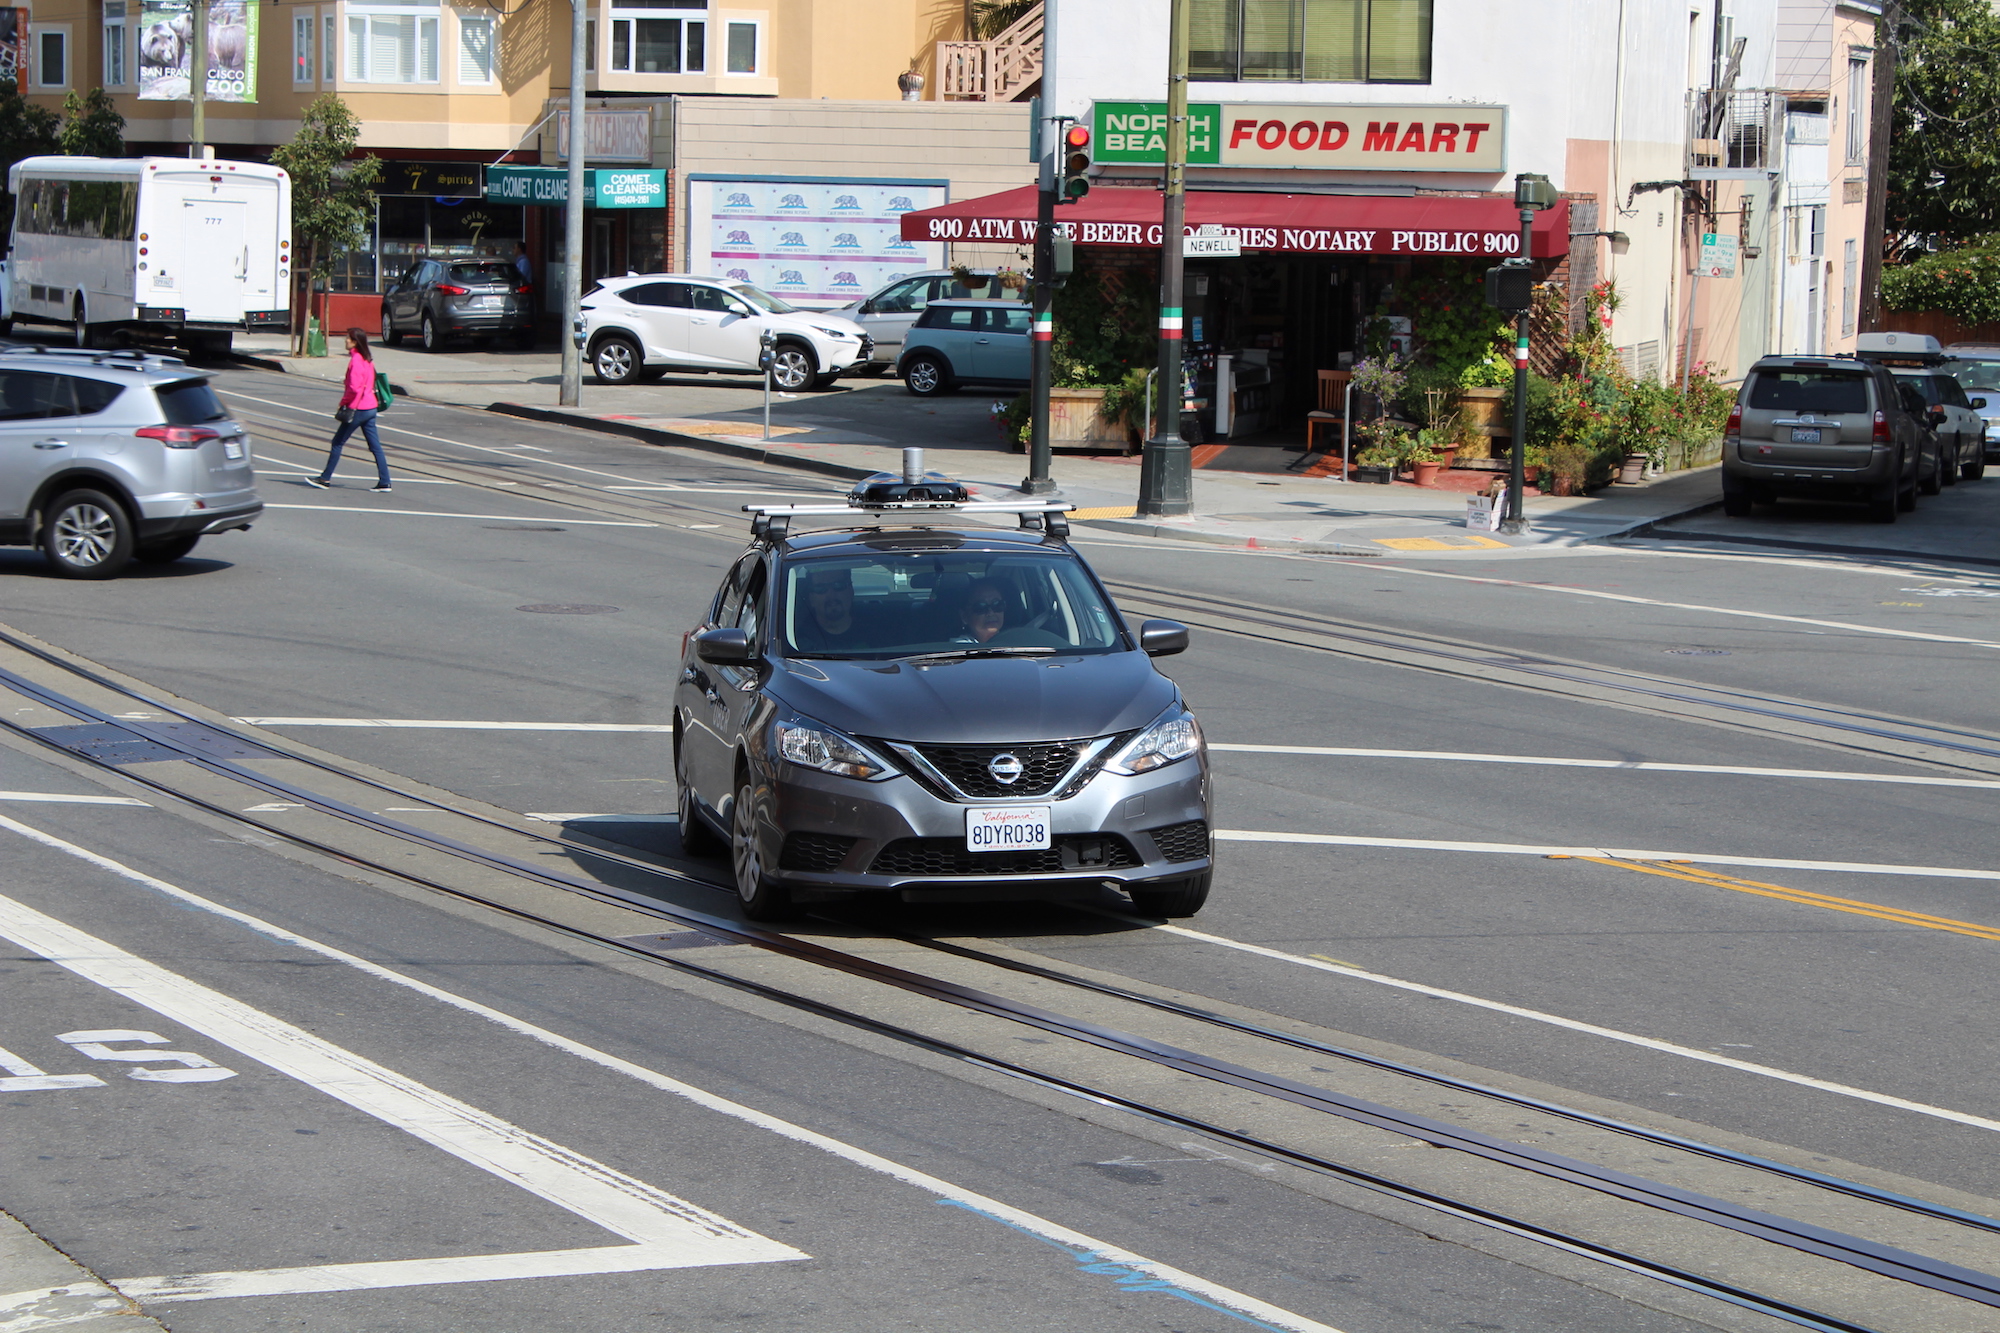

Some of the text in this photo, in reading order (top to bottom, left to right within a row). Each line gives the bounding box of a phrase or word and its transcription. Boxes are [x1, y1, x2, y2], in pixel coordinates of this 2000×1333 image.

[19, 39, 27, 69] AFRICA
[248, 36, 256, 61] NORTH
[141, 67, 163, 77] SAN
[246, 63, 255, 95] AMERICA
[207, 79, 245, 94] ZOO
[1105, 113, 1211, 132] NORH
[1105, 133, 1211, 152] BEAH
[1229, 119, 1490, 153] FOOD MART
[410, 171, 422, 190] 7
[502, 175, 532, 198] COMET
[534, 178, 569, 200] CLEANE
[602, 183, 661, 195] CLEANERS
[611, 174, 651, 185] COMET
[204, 217, 222, 225] 777
[469, 222, 485, 246] 7
[928, 218, 963, 239] 900
[967, 219, 1015, 239] ATM
[1019, 220, 1077, 242] WE
[1081, 222, 1142, 244] BEER
[1282, 229, 1376, 252] NOTARY
[1391, 231, 1479, 253] PUBLIC
[1483, 233, 1520, 253] 900
[1705, 235, 1712, 244] 2
[1190, 241, 1234, 252] NEWELL
[984, 812, 1035, 823] California
[973, 823, 1044, 845] 8DYR038
